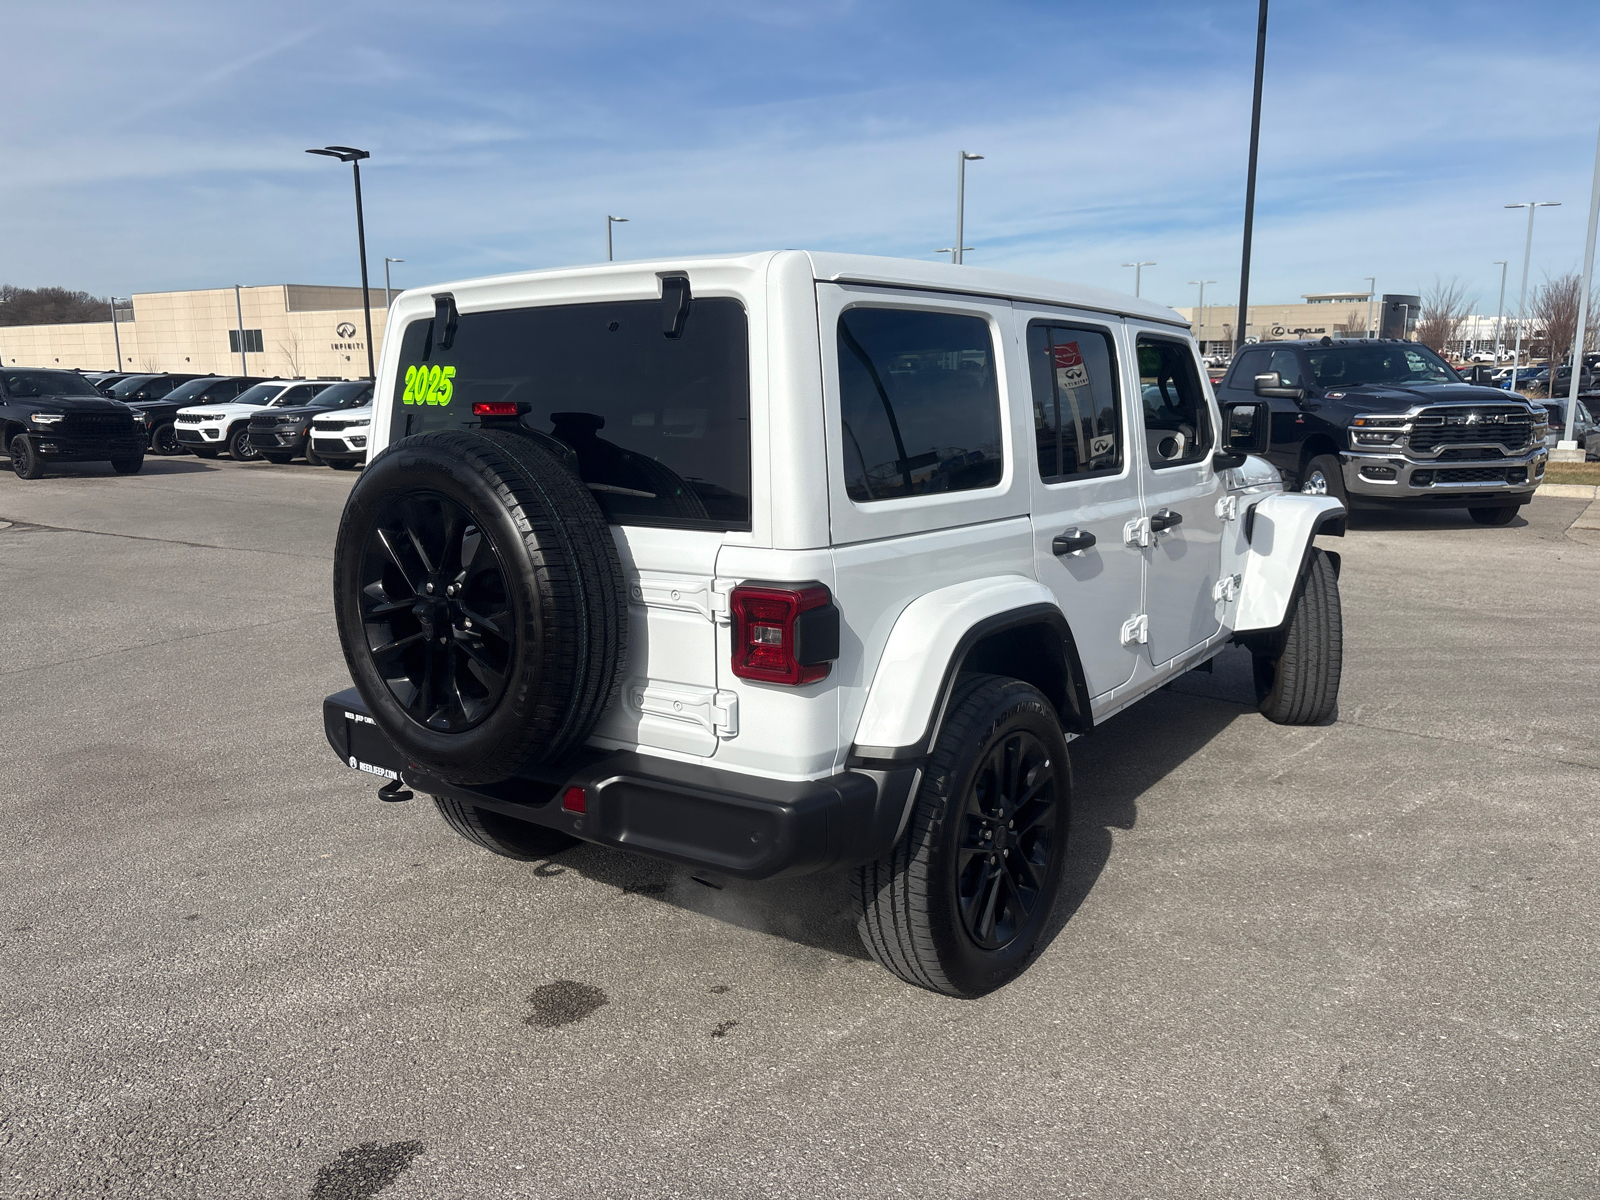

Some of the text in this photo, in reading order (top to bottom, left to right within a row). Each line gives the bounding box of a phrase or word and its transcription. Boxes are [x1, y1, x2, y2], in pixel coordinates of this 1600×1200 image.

[331, 342, 364, 350] INFINITI
[403, 365, 456, 406] 2025
[1447, 415, 1504, 424] RAM
[345, 711, 354, 720] REED
[359, 761, 398, 781] REEDJEEP.COM
